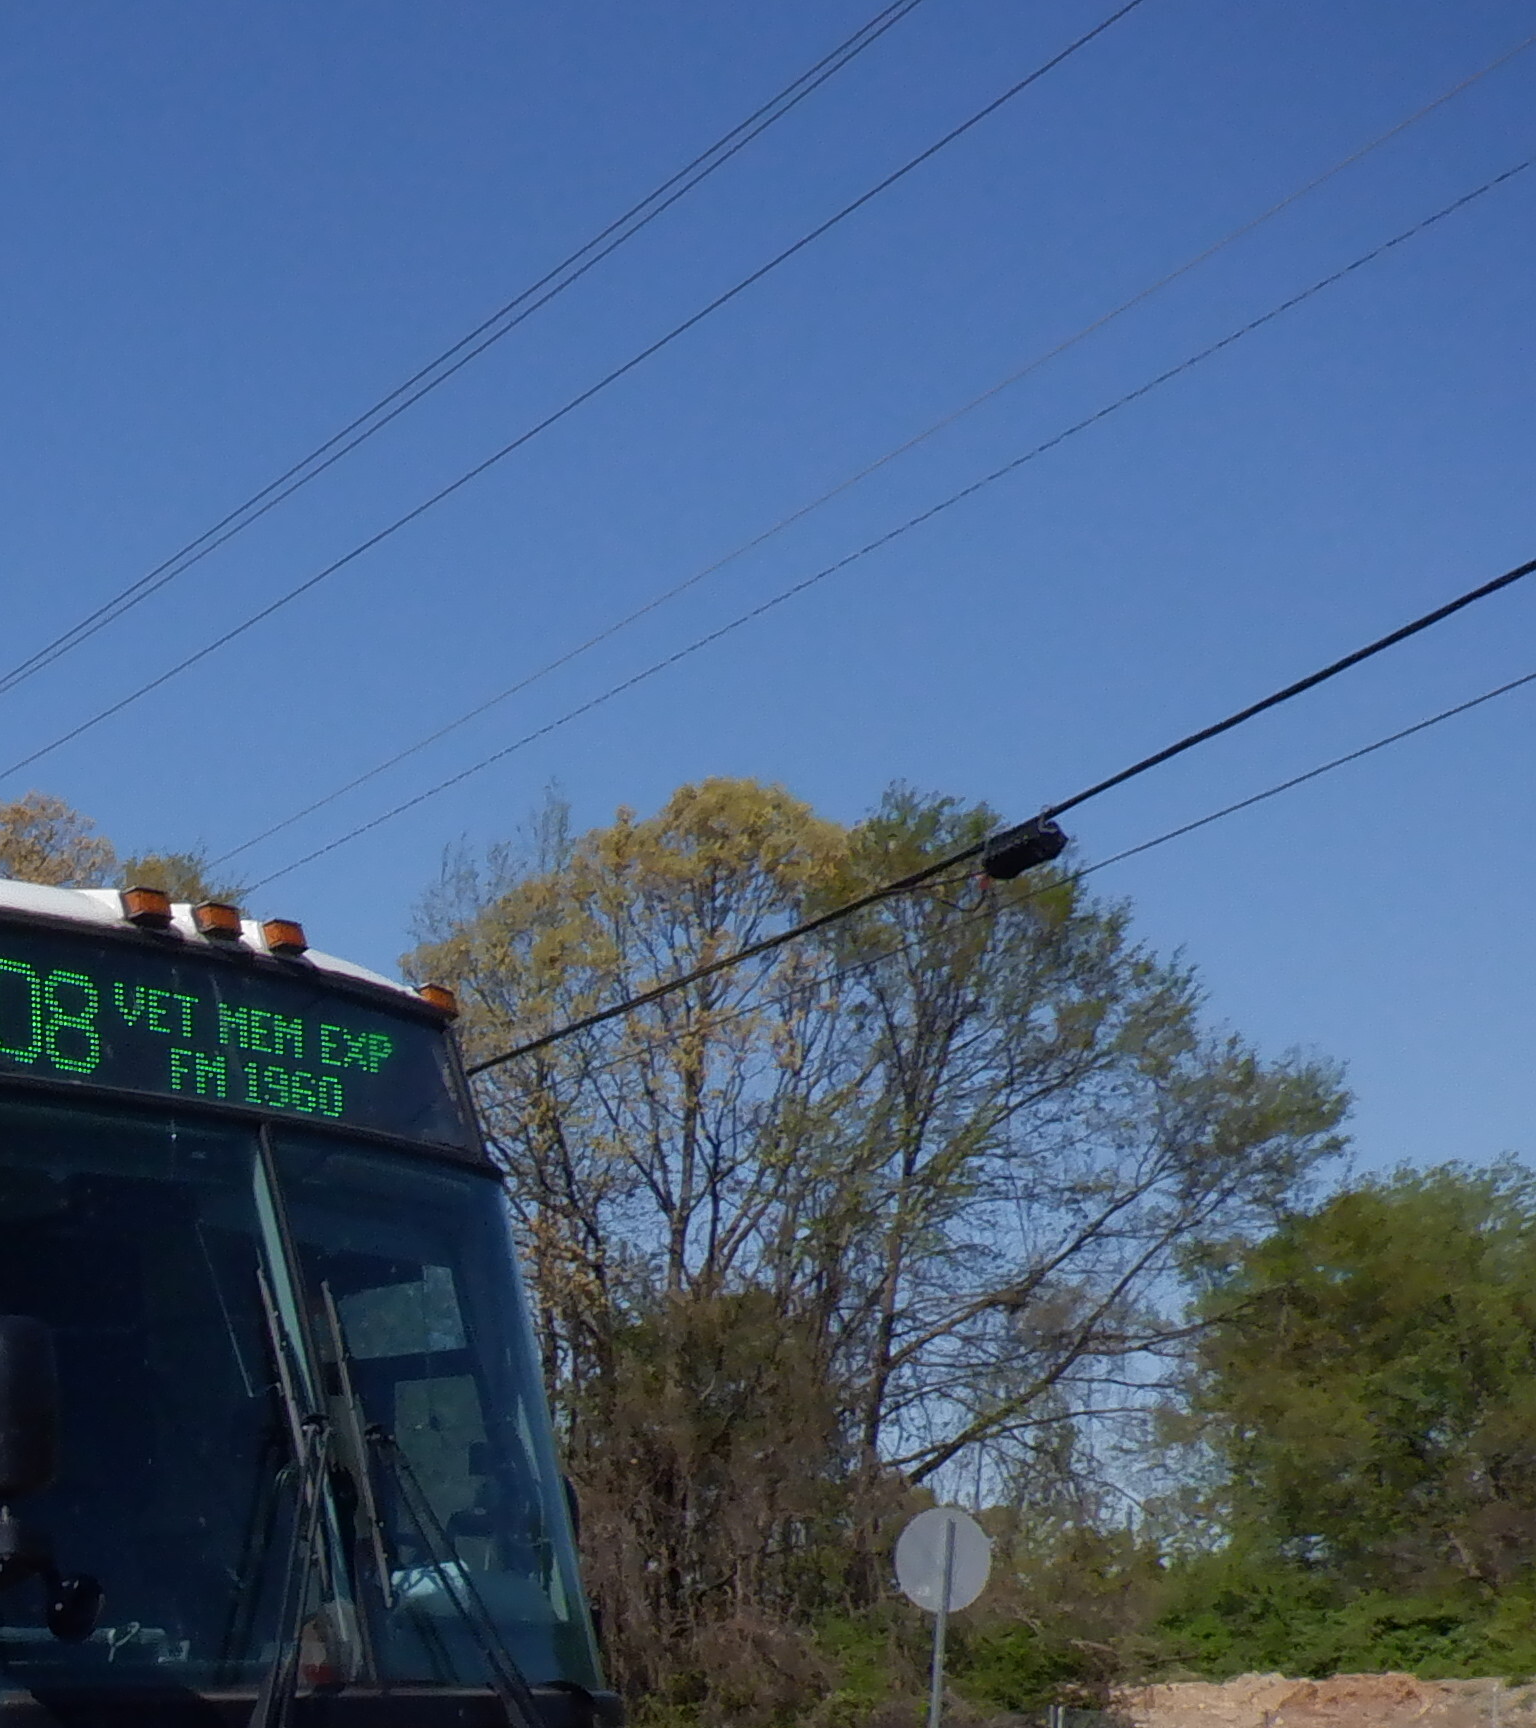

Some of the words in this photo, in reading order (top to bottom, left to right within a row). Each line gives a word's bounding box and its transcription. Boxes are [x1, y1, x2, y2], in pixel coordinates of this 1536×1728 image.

[113, 981, 200, 1038] VET
[219, 1002, 304, 1058] MEM
[320, 1023, 395, 1074] EXP
[170, 1047, 227, 1098] FM
[243, 1062, 345, 1118] 1960
